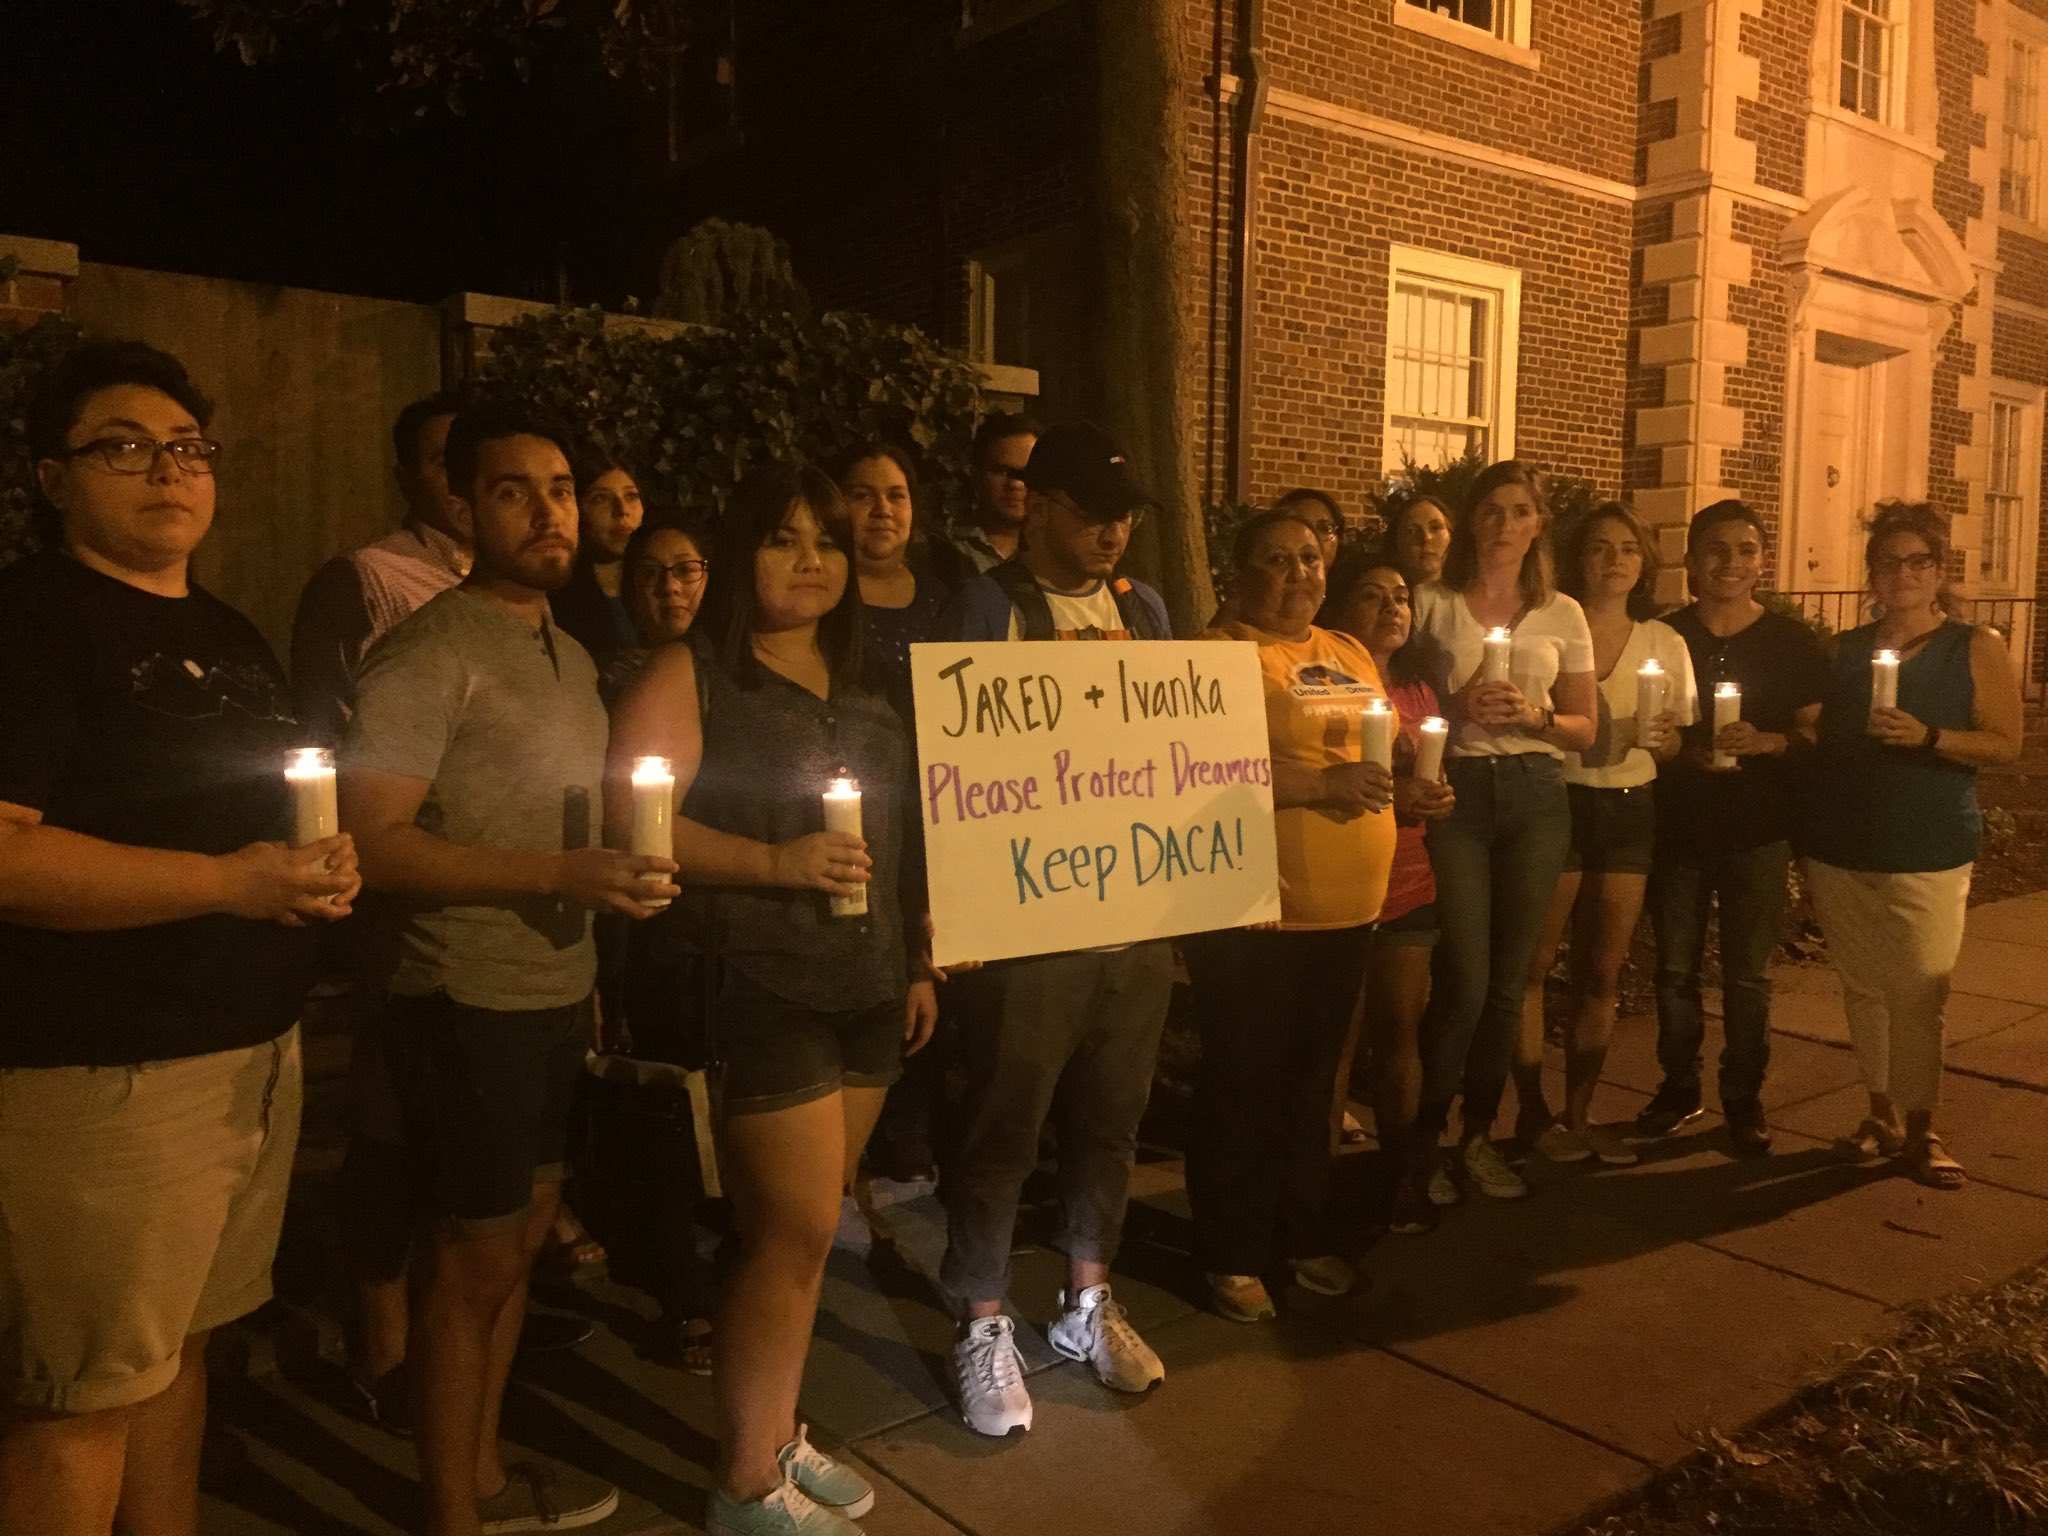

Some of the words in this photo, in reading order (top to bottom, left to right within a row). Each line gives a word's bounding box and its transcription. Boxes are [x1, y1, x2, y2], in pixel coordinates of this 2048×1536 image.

[939, 657, 1062, 738] JARED
[1118, 659, 1226, 723] Ivanka
[927, 762, 1042, 825] Please
[1053, 749, 1158, 806] Protect
[1169, 741, 1271, 796] Dreamers
[1011, 836, 1117, 905] Keep
[1131, 817, 1243, 887] DACA!
